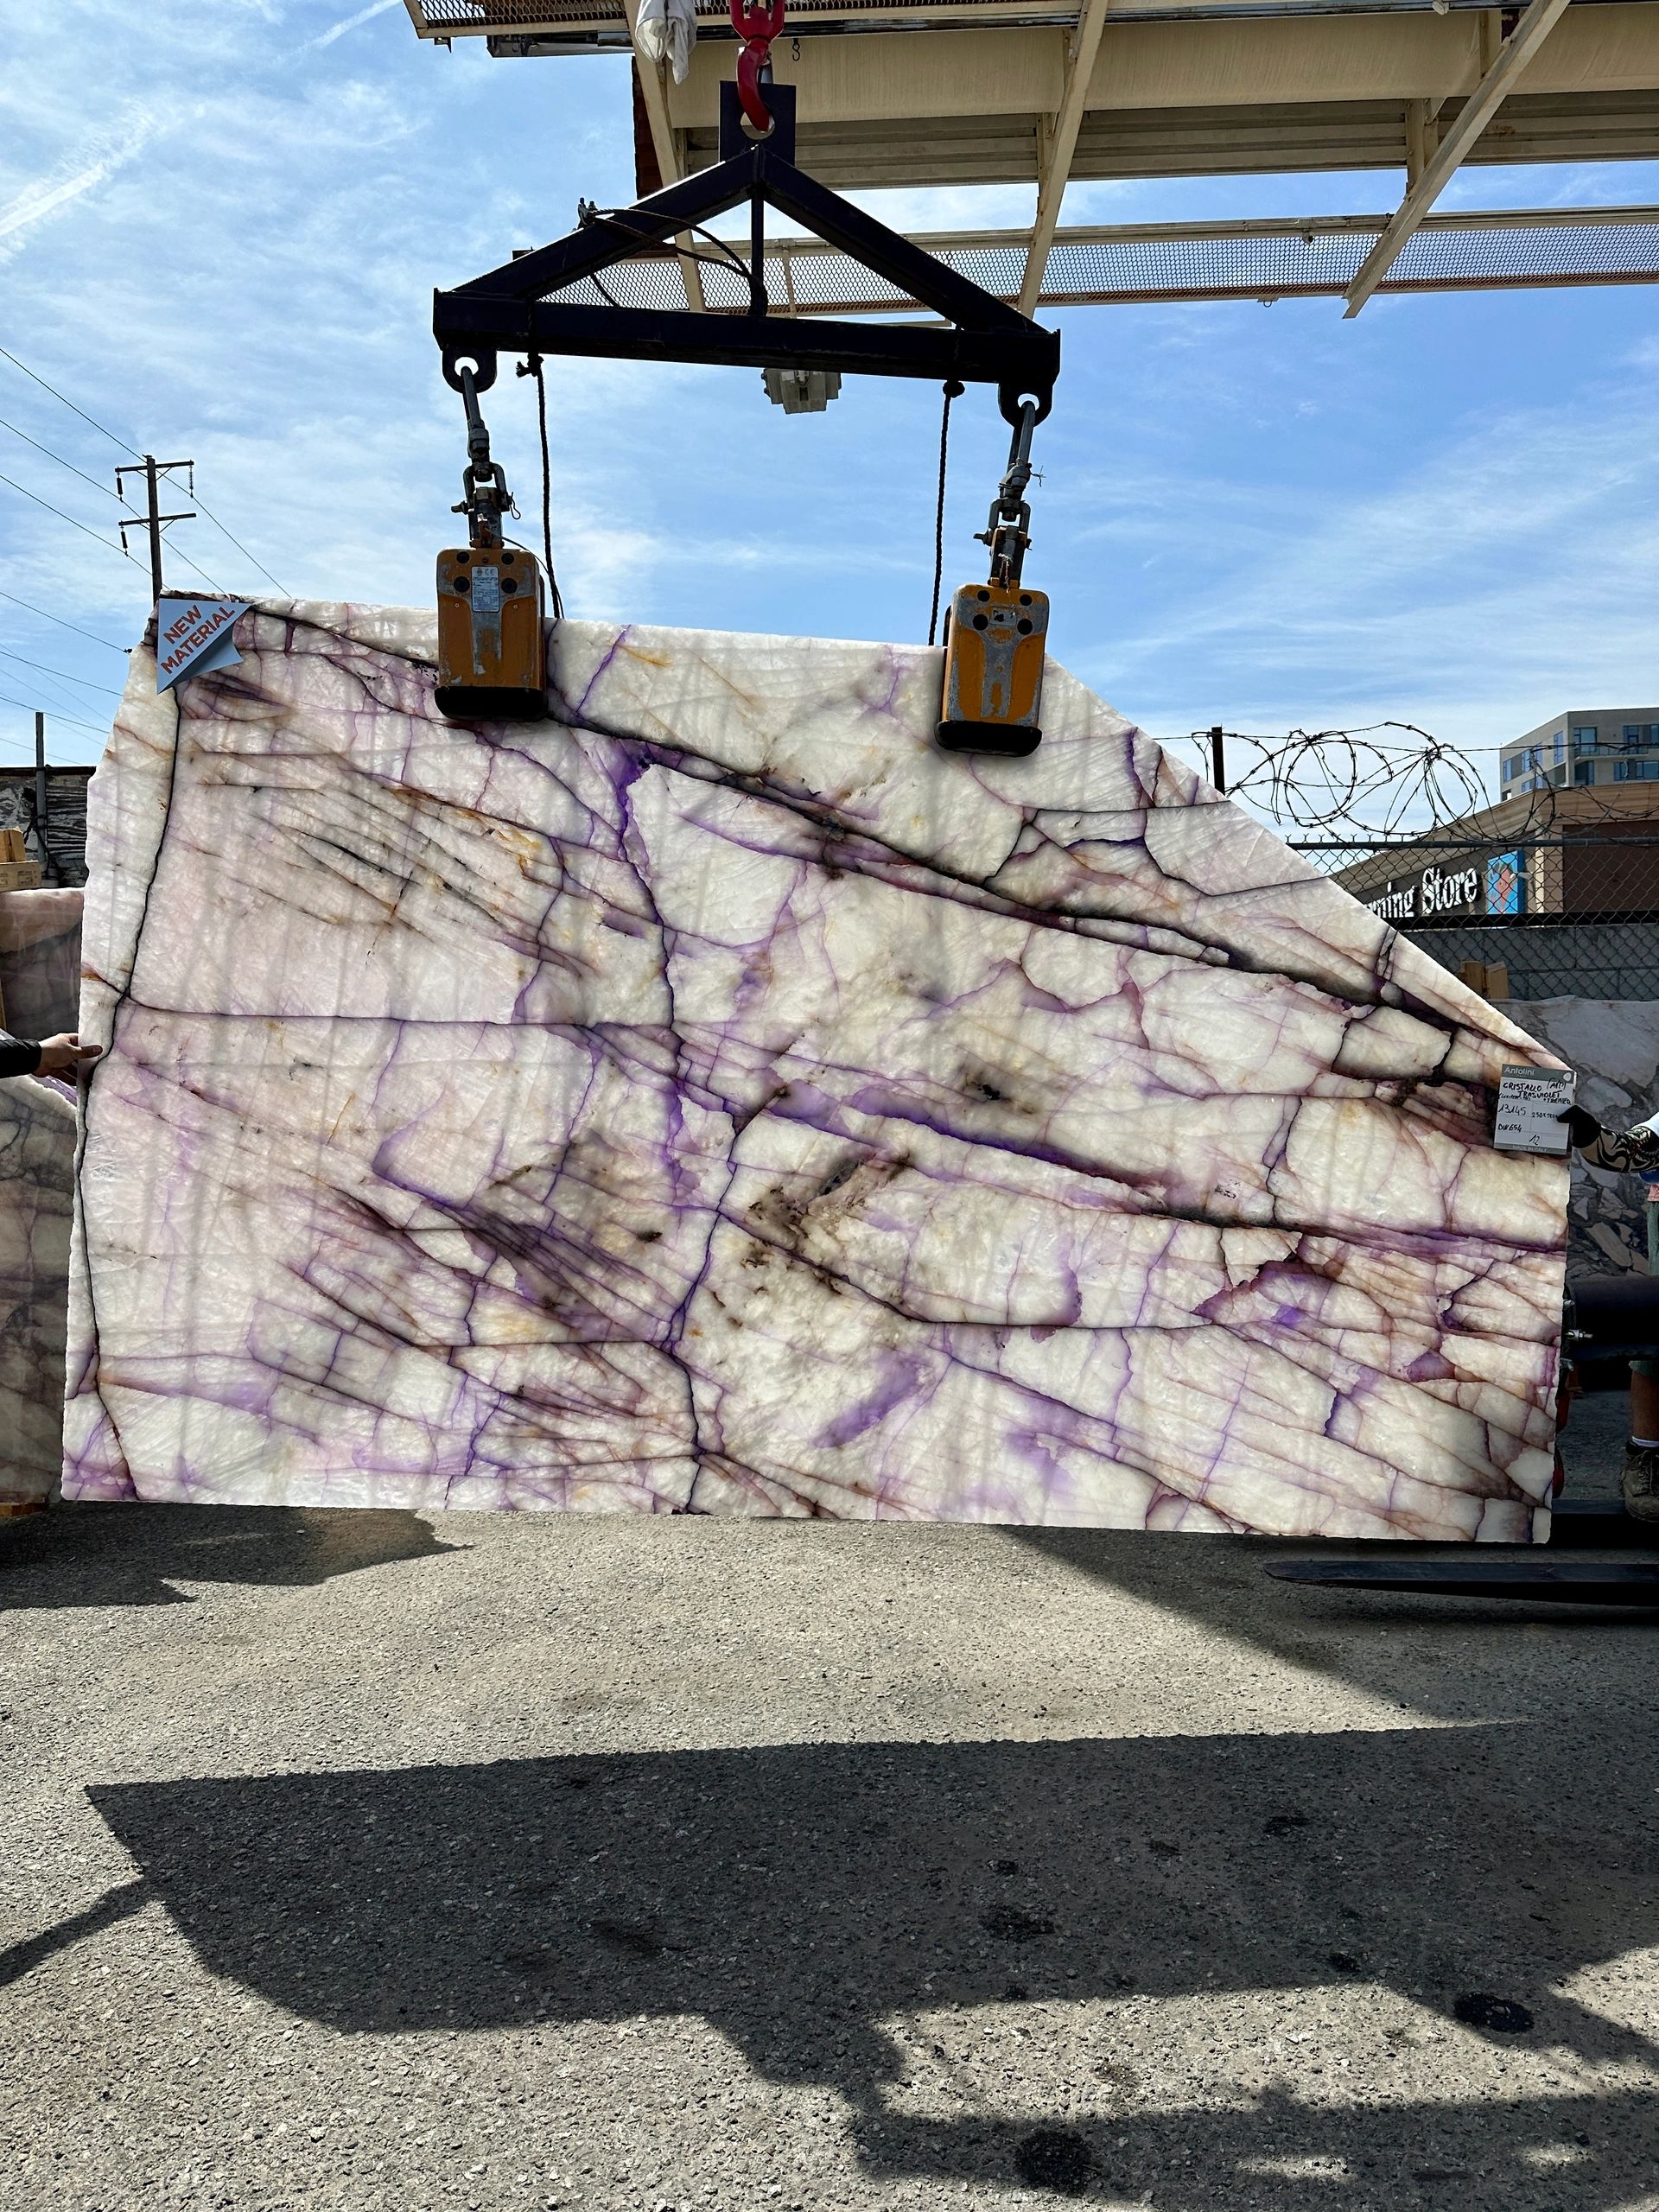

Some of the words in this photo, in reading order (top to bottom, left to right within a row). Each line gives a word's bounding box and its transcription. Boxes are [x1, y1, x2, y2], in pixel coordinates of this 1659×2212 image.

[161, 607, 235, 675] MATERIAL
[163, 605, 202, 645] NEW
[1422, 867, 1478, 914] Store
[1504, 1066, 1535, 1076] Antolini
[1529, 1135, 1541, 1146] 12
